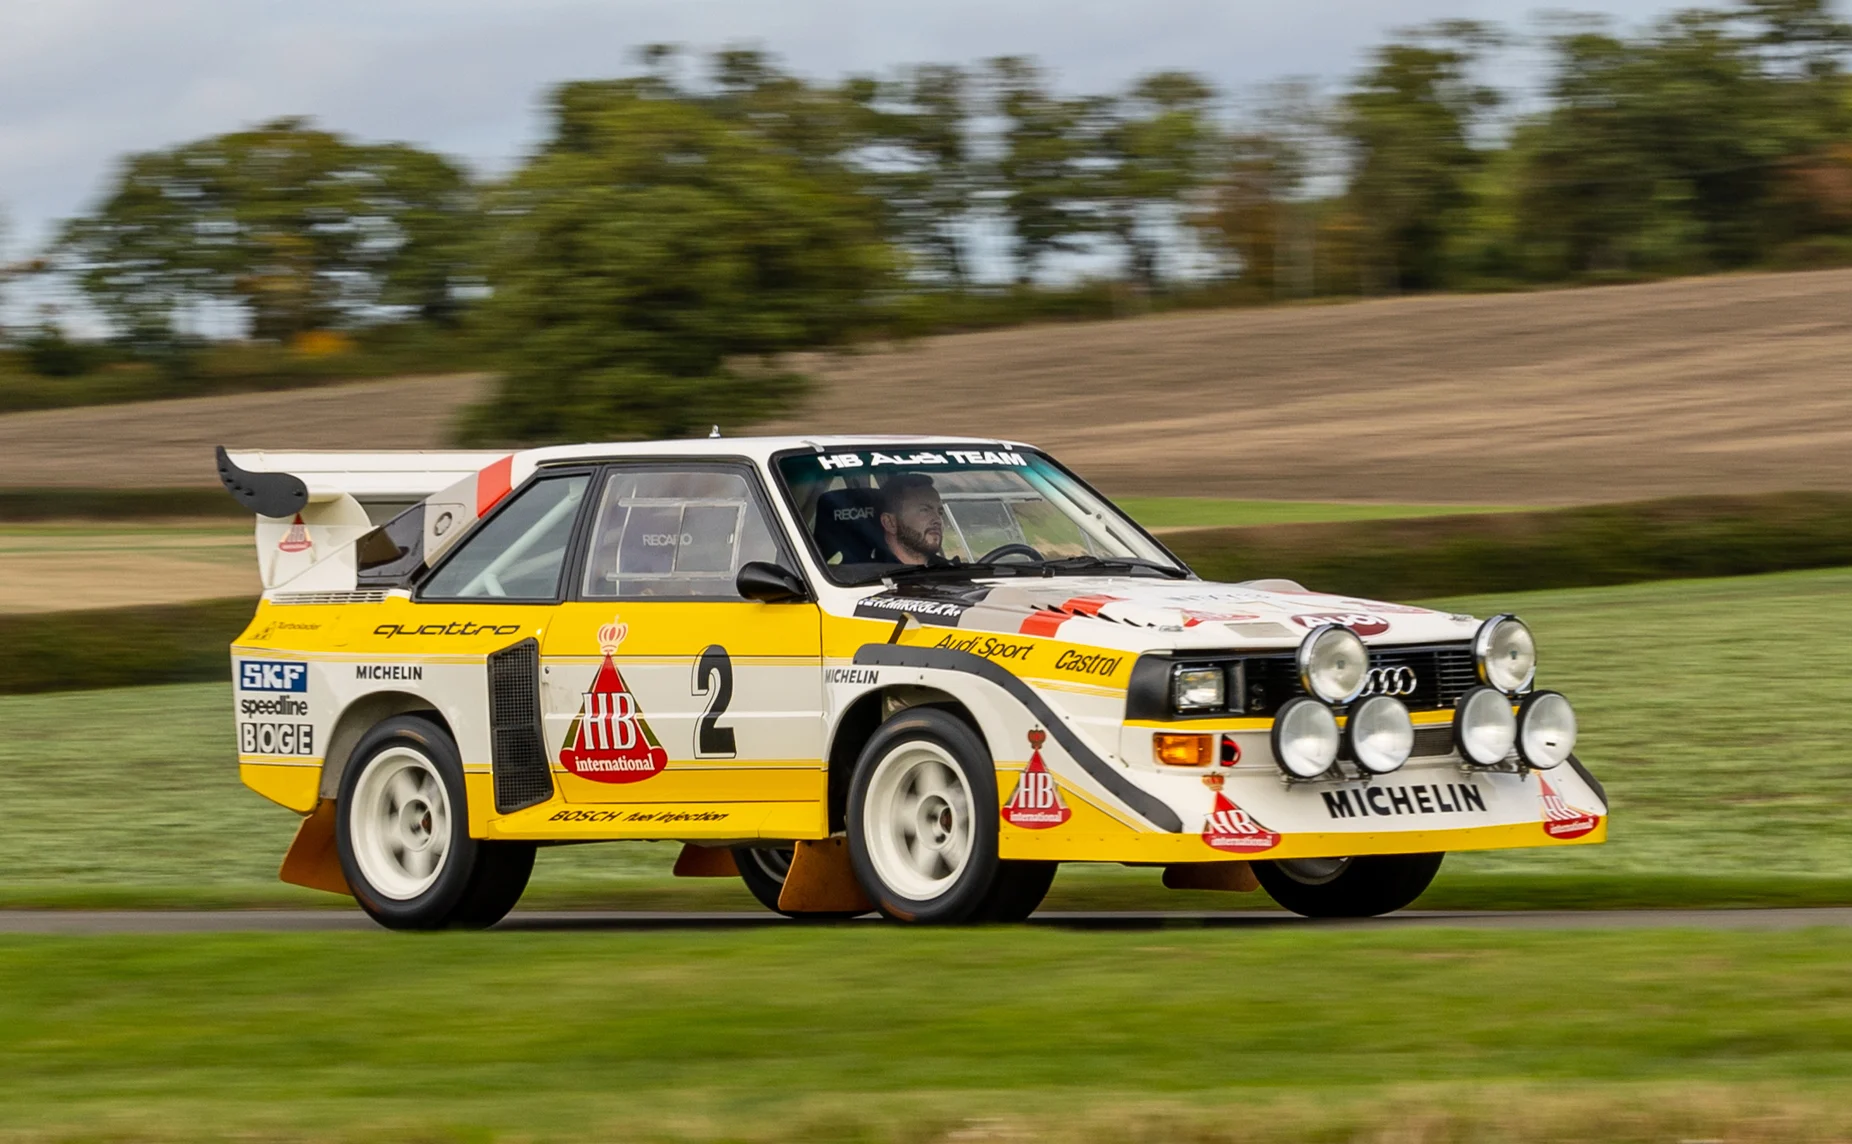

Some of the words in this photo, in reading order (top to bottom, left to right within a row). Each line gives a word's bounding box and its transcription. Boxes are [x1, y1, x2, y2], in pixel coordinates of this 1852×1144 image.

[817, 453, 864, 470] HB
[946, 451, 1027, 466] TEAM
[374, 621, 521, 637] quattro
[934, 634, 980, 653] Audi
[978, 638, 1034, 661] Sport
[356, 666, 423, 680] MICHELIN
[1055, 650, 1123, 677] Castrol
[242, 664, 305, 689] SKF
[824, 669, 879, 684] MICHELIN
[241, 695, 308, 719] speedline
[691, 644, 737, 759] 2
[582, 692, 637, 750] HB
[242, 723, 313, 755] BOGE
[575, 754, 655, 772] international
[1018, 772, 1054, 808] HB
[1321, 784, 1487, 819] MICHELIN
[548, 811, 623, 821] BOSCH
[624, 812, 656, 821] fuel
[655, 811, 729, 823] injection
[1538, 795, 1582, 820] HB
[1205, 809, 1259, 834] HB
